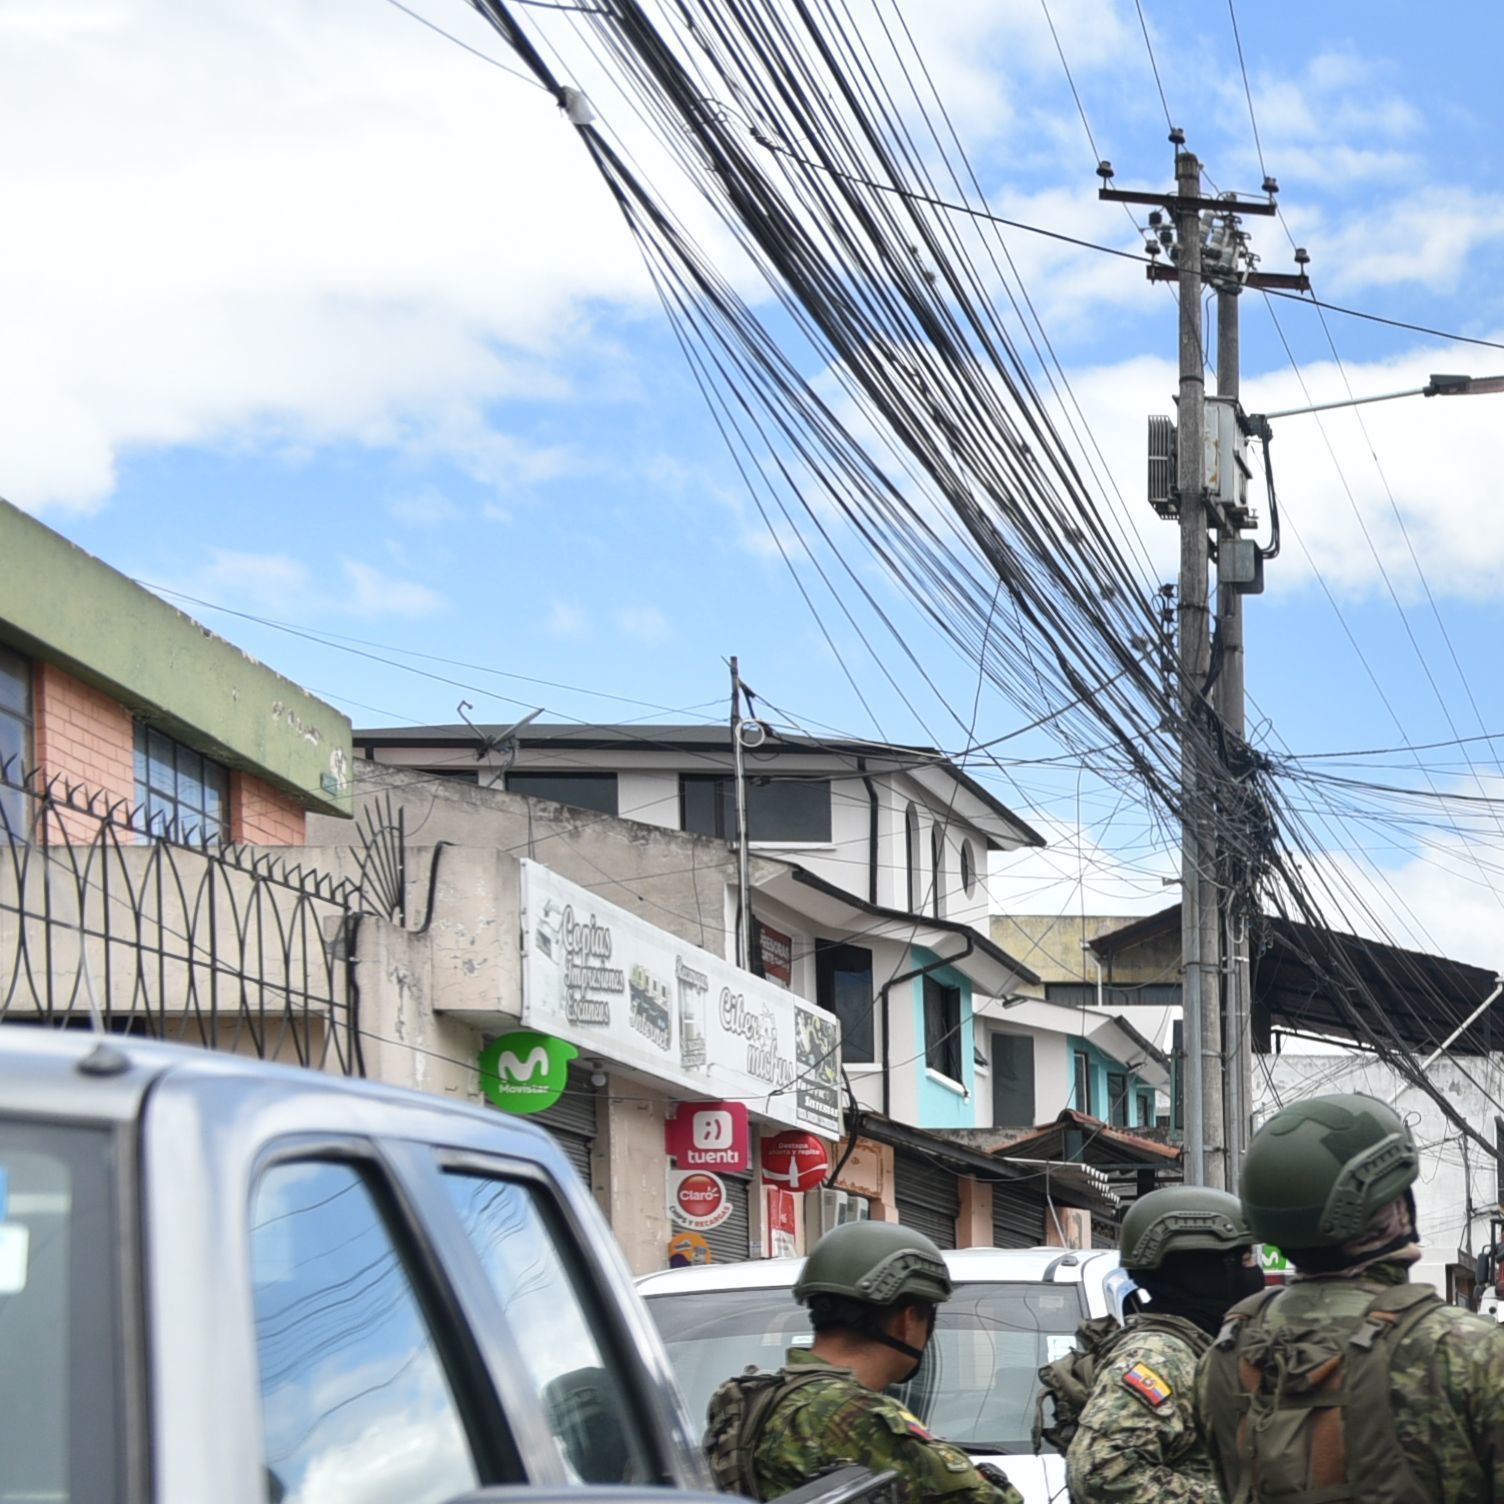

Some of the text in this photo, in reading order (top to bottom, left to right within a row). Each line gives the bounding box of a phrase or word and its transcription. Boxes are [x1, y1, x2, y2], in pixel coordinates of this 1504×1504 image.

[562, 904, 612, 963] Copias
[564, 956, 625, 998] Impresiones
[687, 1149, 739, 1164] tuenti
[679, 1188, 716, 1201] Claro
[694, 1206, 731, 1228] RECARGAS
